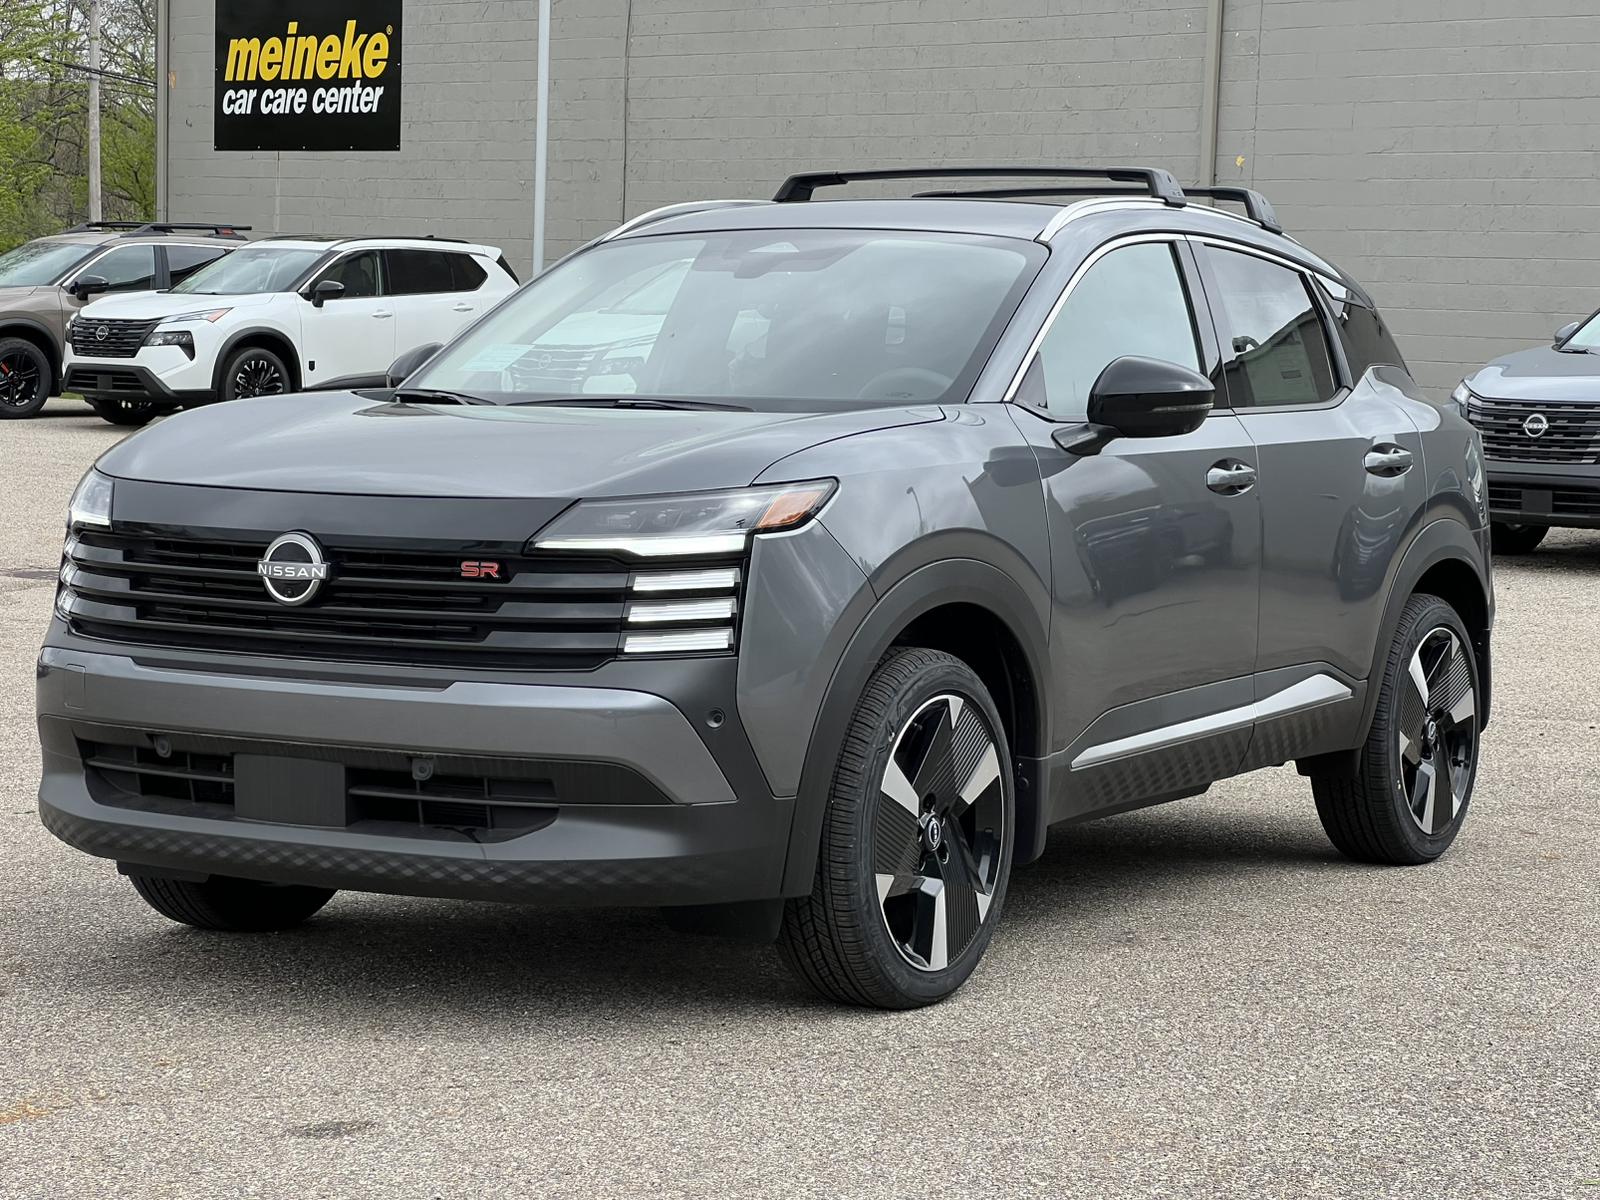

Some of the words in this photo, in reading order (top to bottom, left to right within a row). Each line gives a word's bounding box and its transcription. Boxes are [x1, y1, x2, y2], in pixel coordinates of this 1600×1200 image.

[224, 19, 390, 81] meineke
[222, 88, 257, 115] car
[260, 87, 308, 115] care
[312, 80, 384, 114] center
[258, 563, 324, 578] NISSAN
[460, 561, 499, 578] SR
